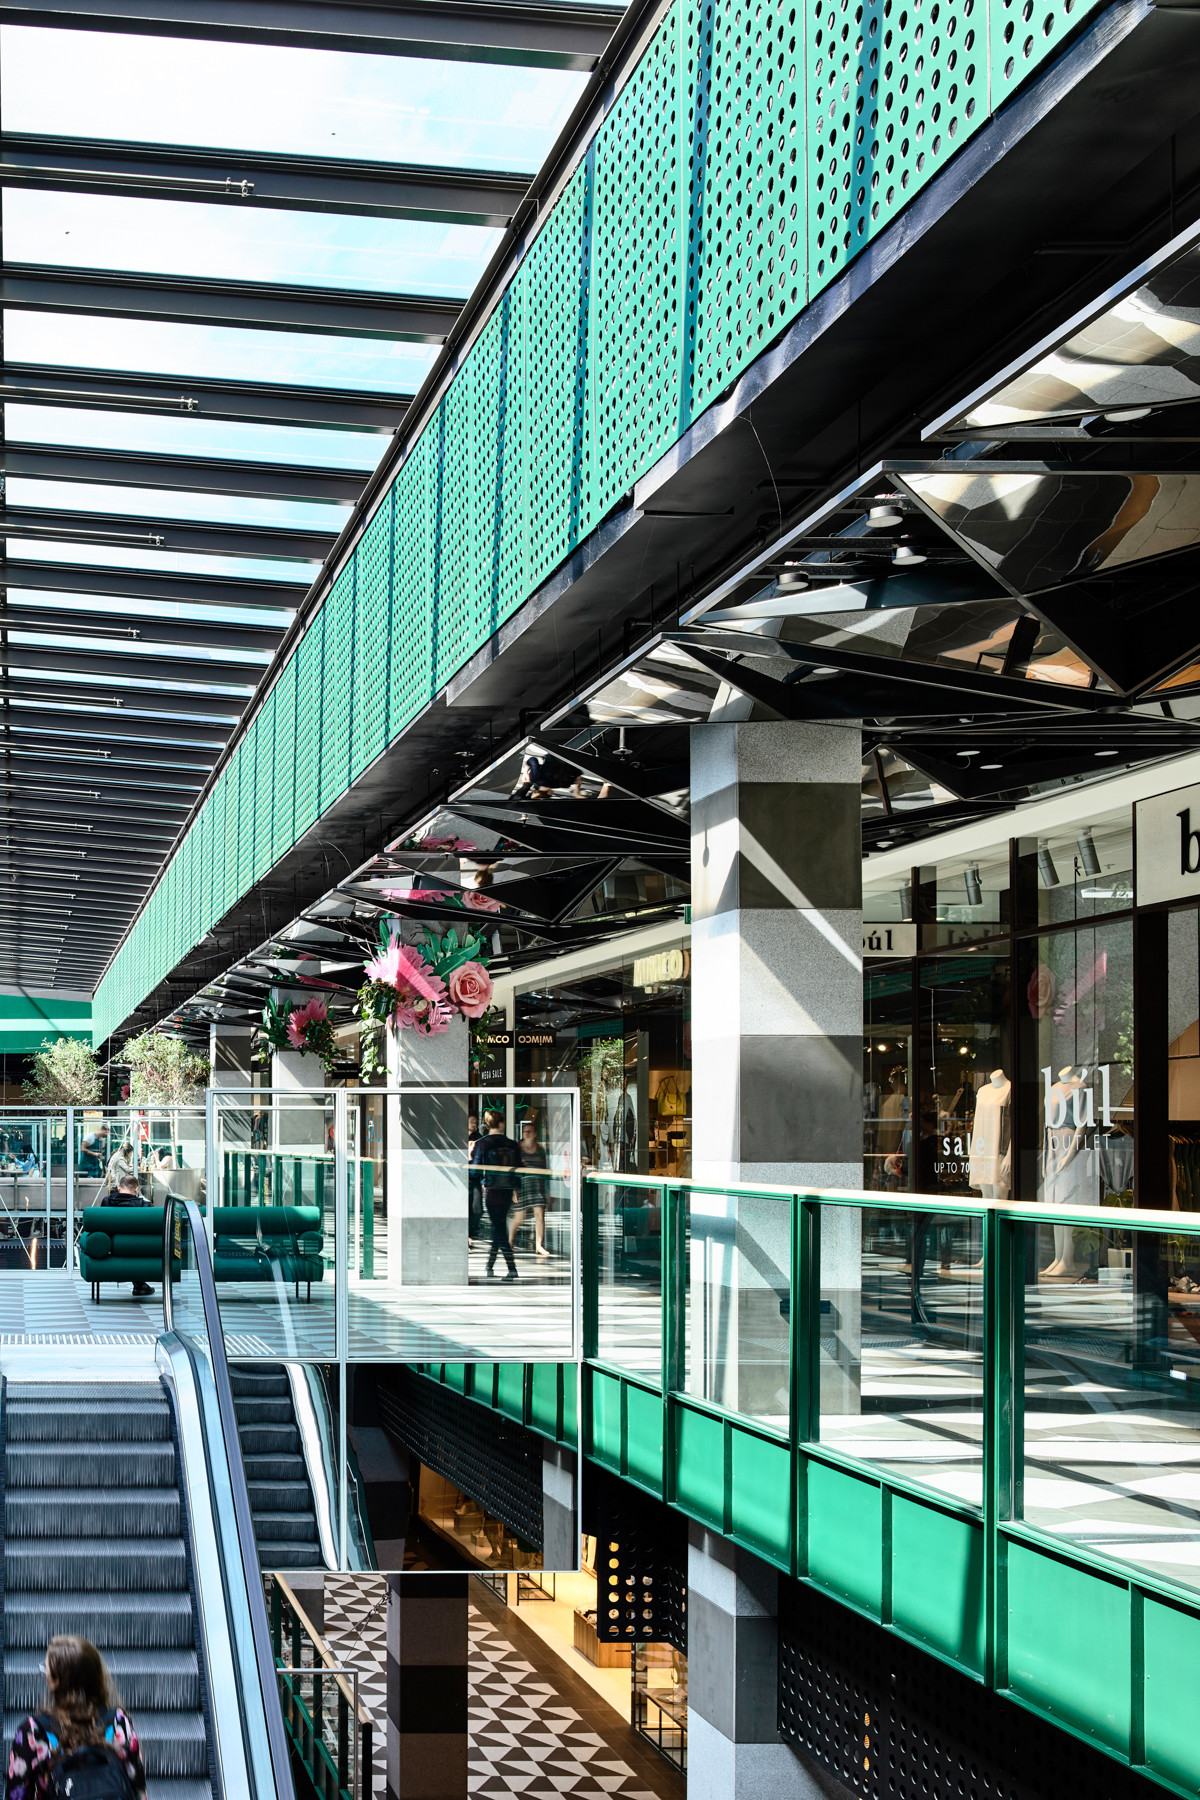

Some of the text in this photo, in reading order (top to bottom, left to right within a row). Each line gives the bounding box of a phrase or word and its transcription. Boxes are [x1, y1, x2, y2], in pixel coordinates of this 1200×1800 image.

[863, 927, 894, 950] úl
[476, 1035, 510, 1044] MMCO
[492, 1068, 503, 1079] SALE
[1041, 1064, 1115, 1129] búl
[942, 1133, 985, 1156] sale
[1050, 1134, 1111, 1151] OUTLET
[934, 1162, 945, 1174] UP
[945, 1162, 957, 1174] TO
